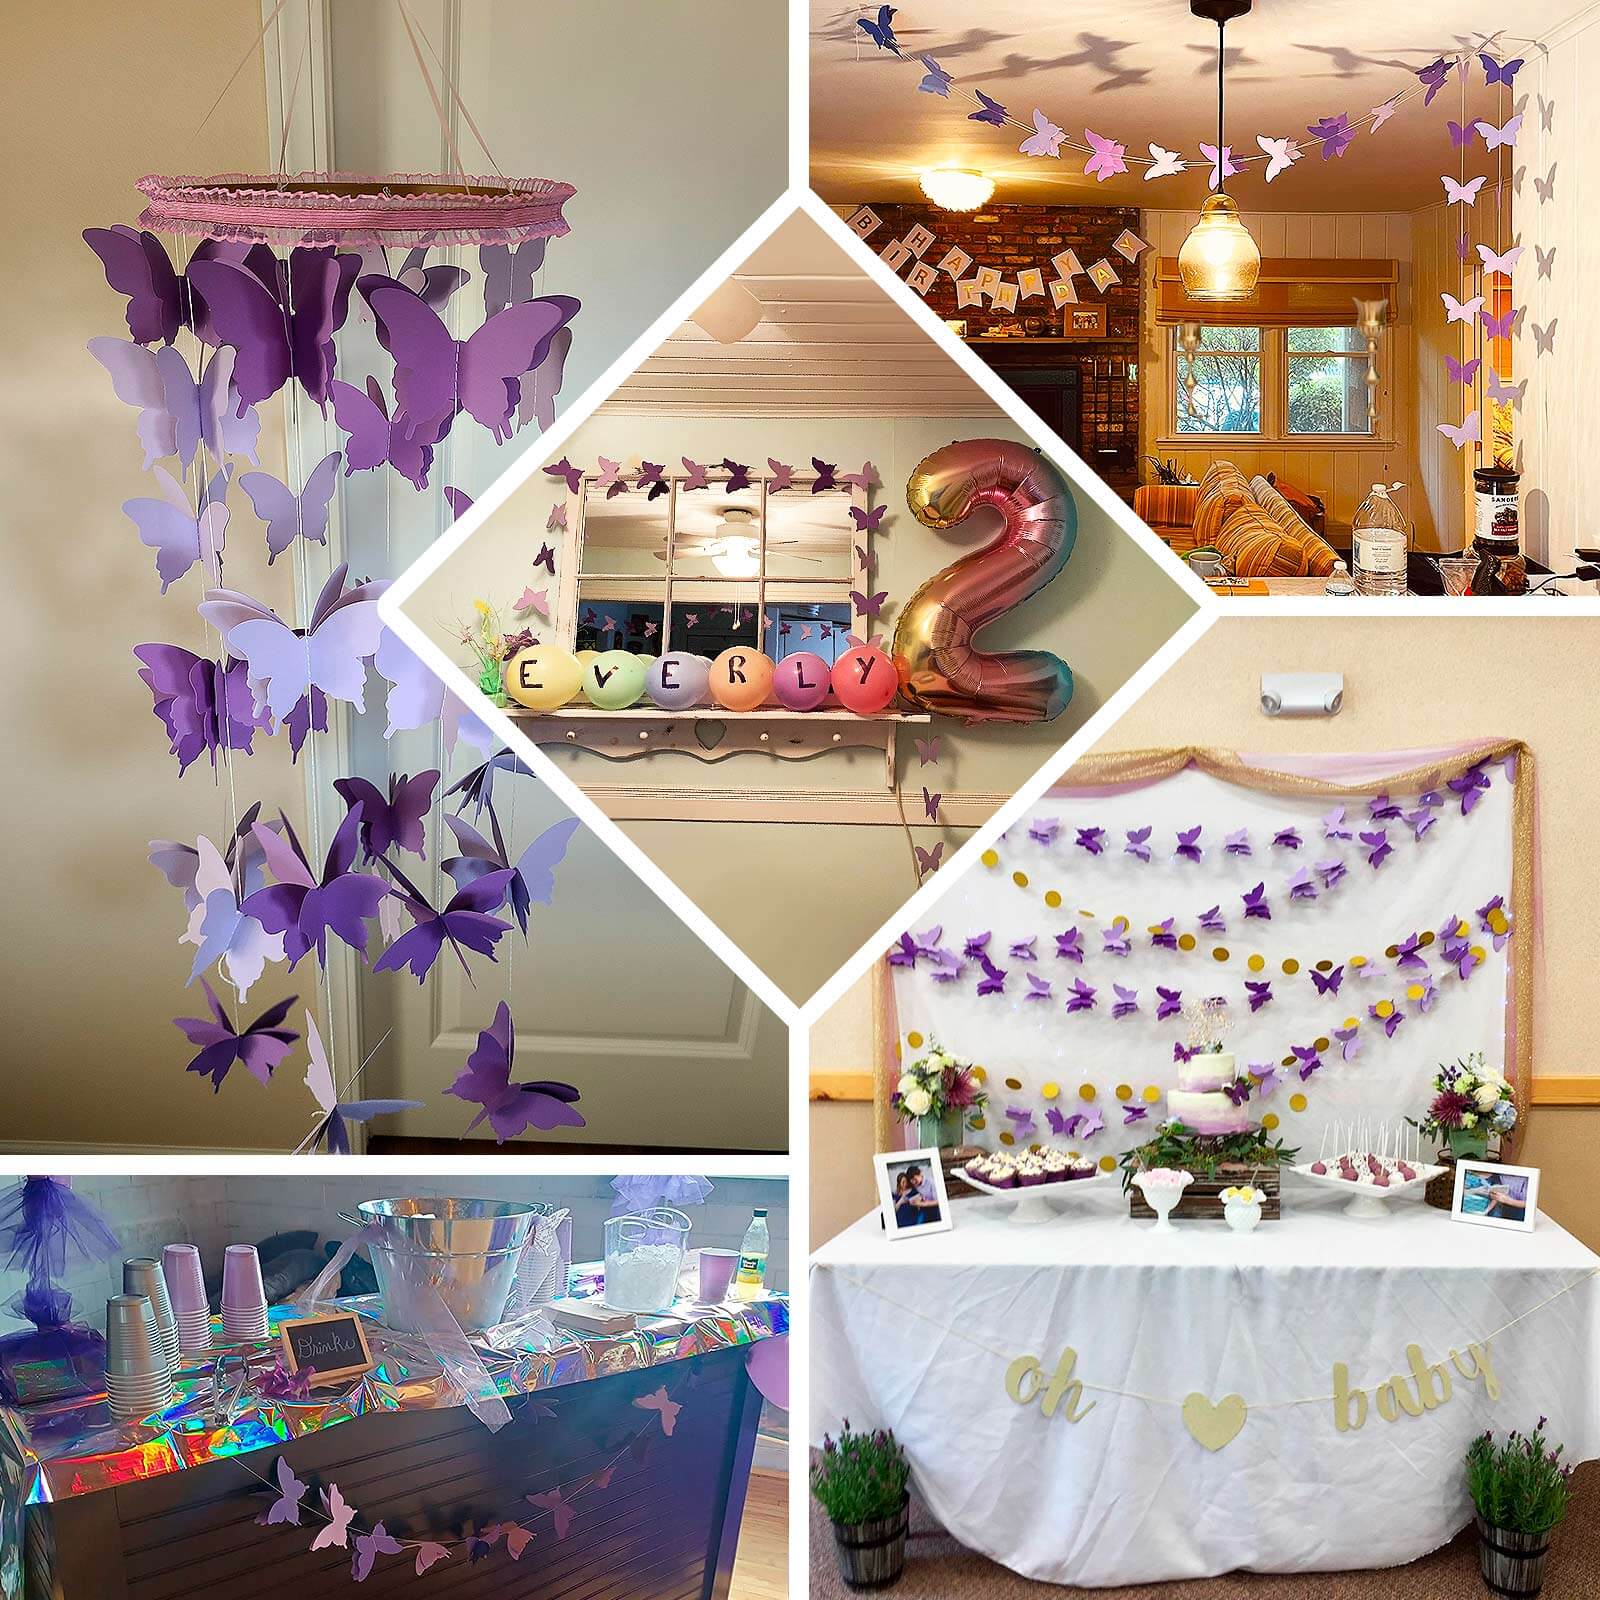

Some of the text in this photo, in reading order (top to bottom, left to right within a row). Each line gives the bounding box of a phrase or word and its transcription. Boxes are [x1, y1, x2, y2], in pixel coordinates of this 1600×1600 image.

[892, 438, 1078, 723] 2
[519, 655, 876, 690] EVERLY
[297, 1331, 356, 1360] Drinks
[1004, 1342, 1501, 1432] oh baby
